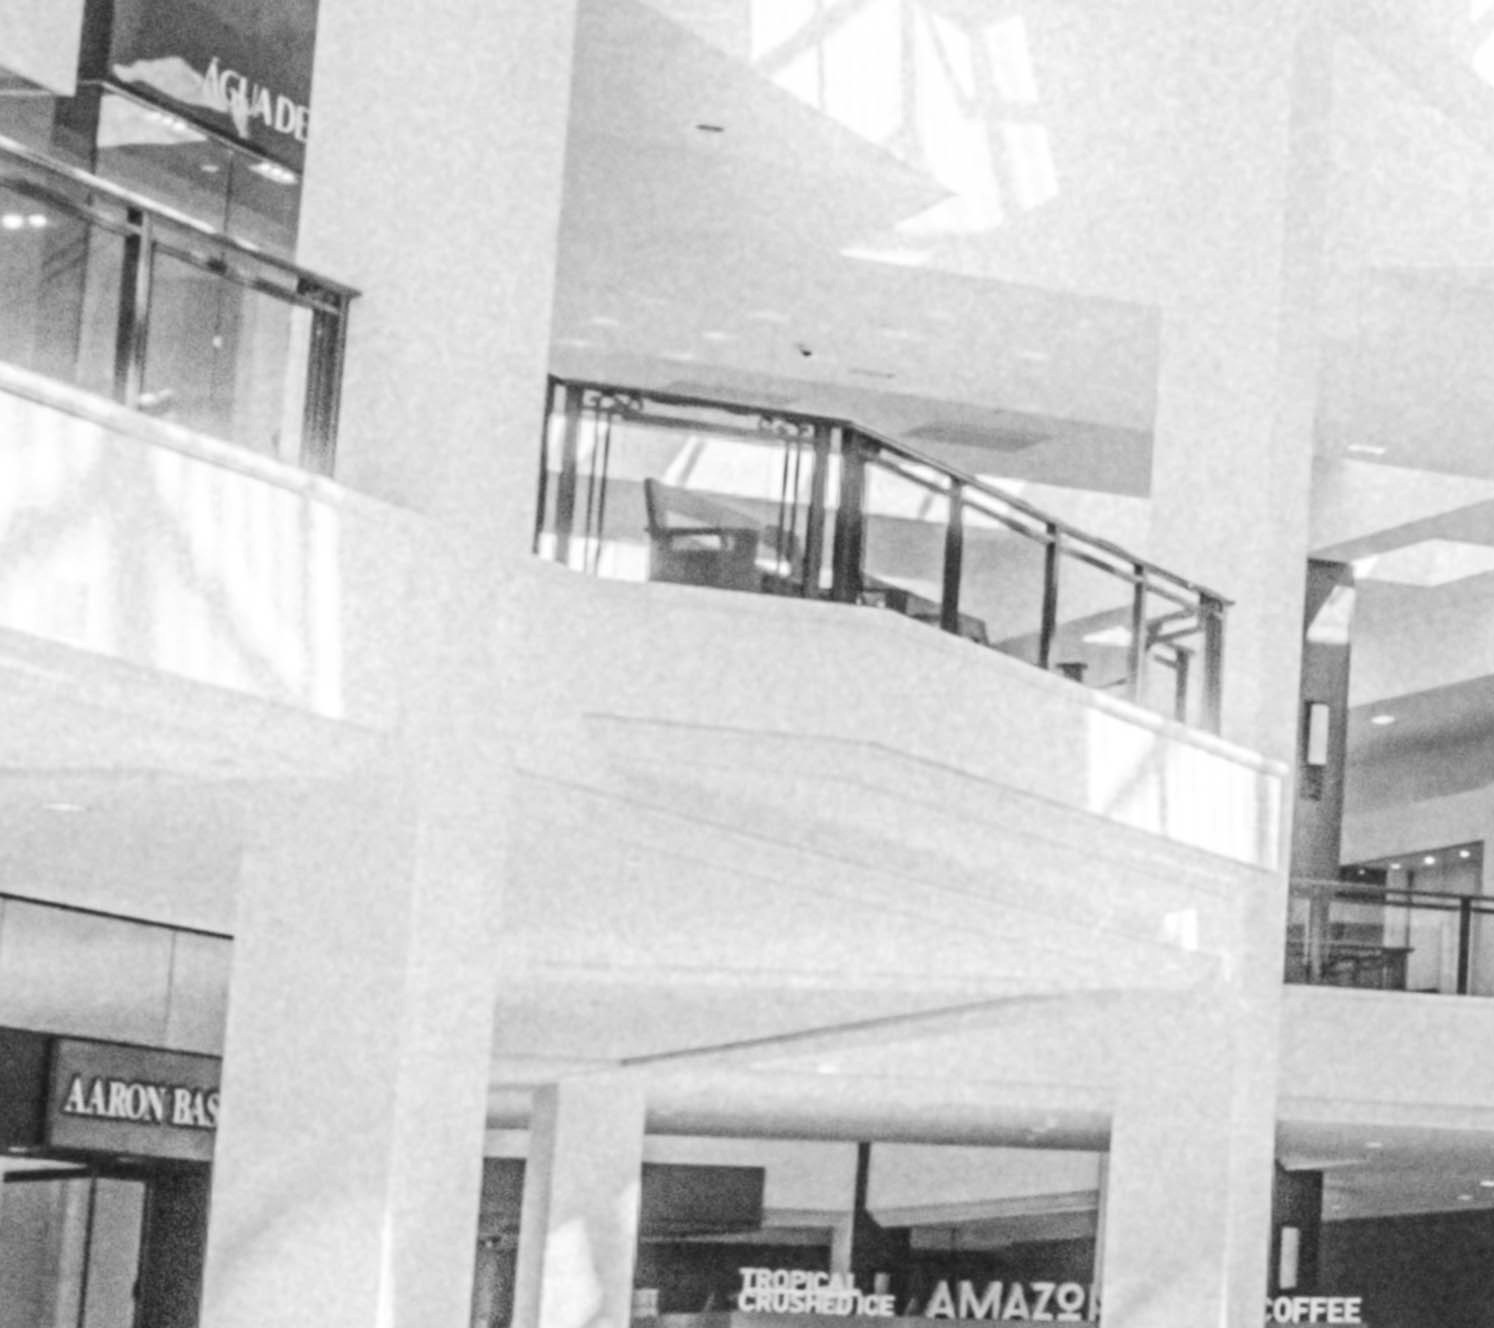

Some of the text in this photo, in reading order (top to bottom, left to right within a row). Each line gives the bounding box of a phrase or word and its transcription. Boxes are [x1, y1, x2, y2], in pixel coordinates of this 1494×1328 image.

[63, 1076, 166, 1122] AARON
[738, 1267, 859, 1296] TROPICAL
[738, 1289, 897, 1318] CRUSHED ICE
